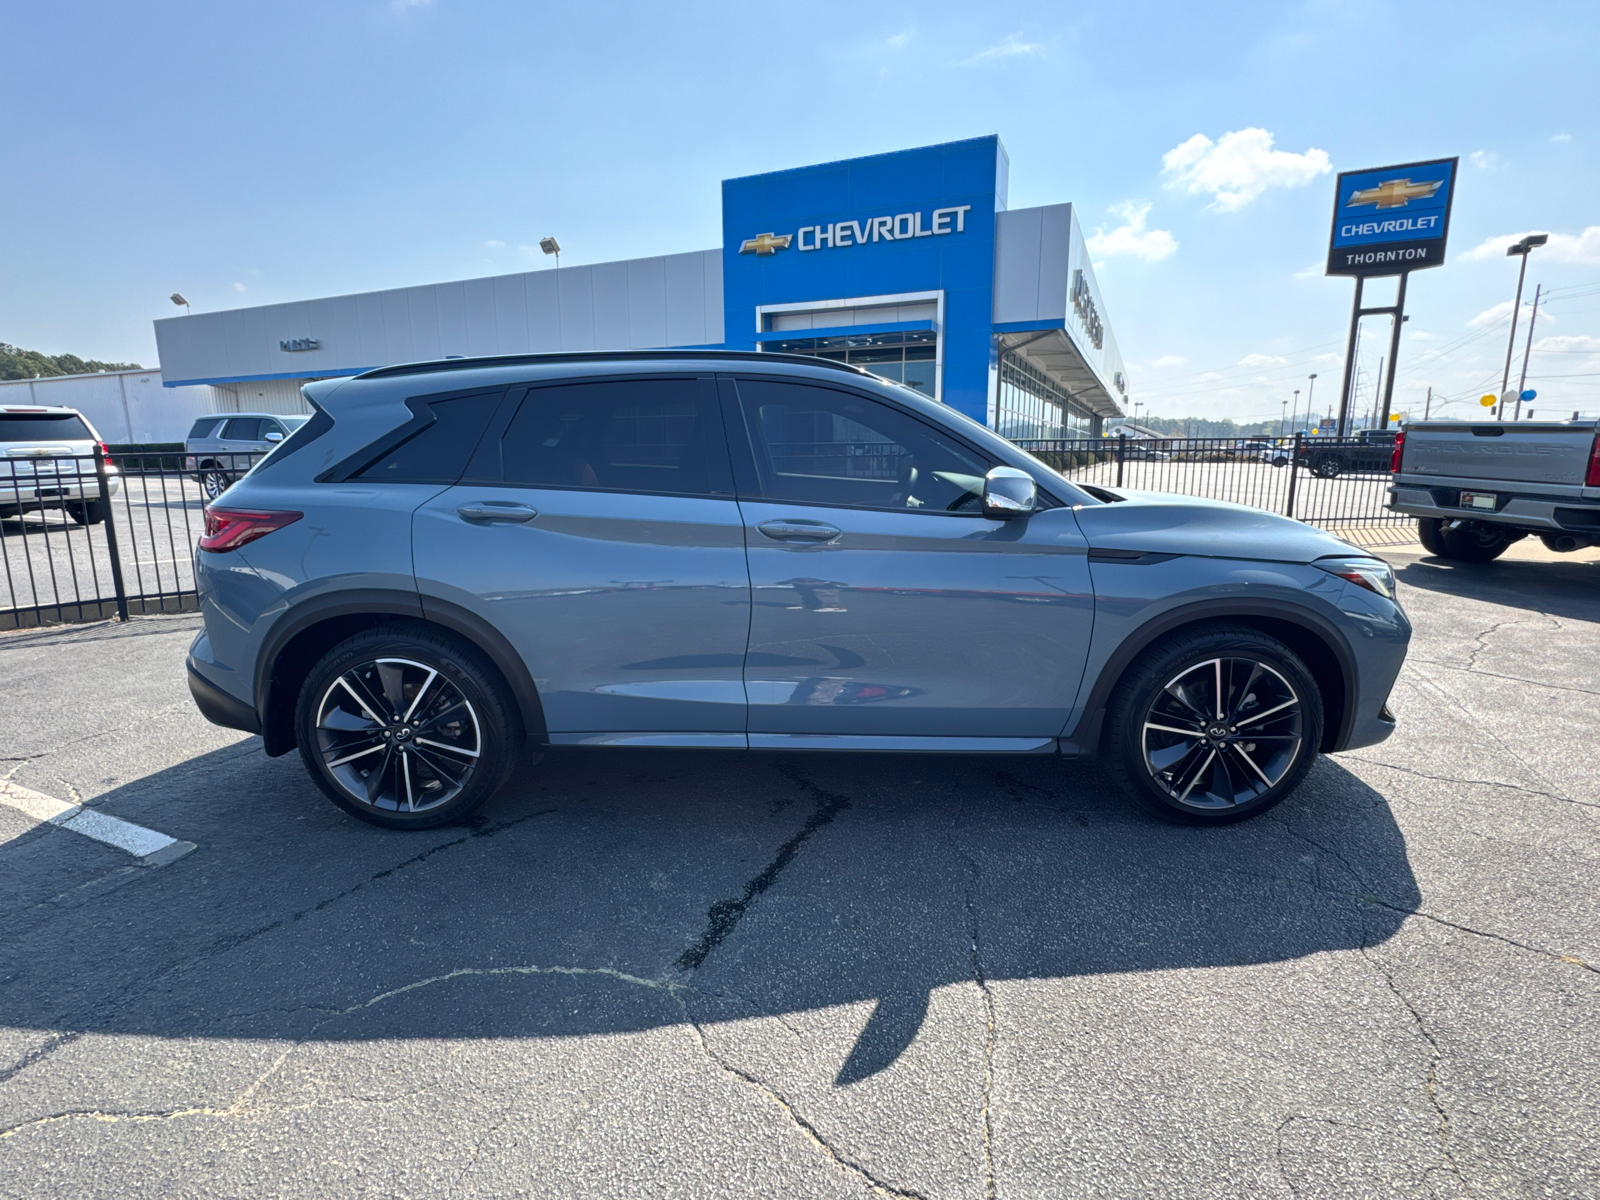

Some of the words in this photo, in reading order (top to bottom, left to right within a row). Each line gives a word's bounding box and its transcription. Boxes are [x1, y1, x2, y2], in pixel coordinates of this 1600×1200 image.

[797, 205, 971, 251] CHEVROLET
[1341, 216, 1439, 237] CHEVROLET
[1346, 247, 1427, 265] THORNTON
[1412, 443, 1574, 457] CHEVROLET
